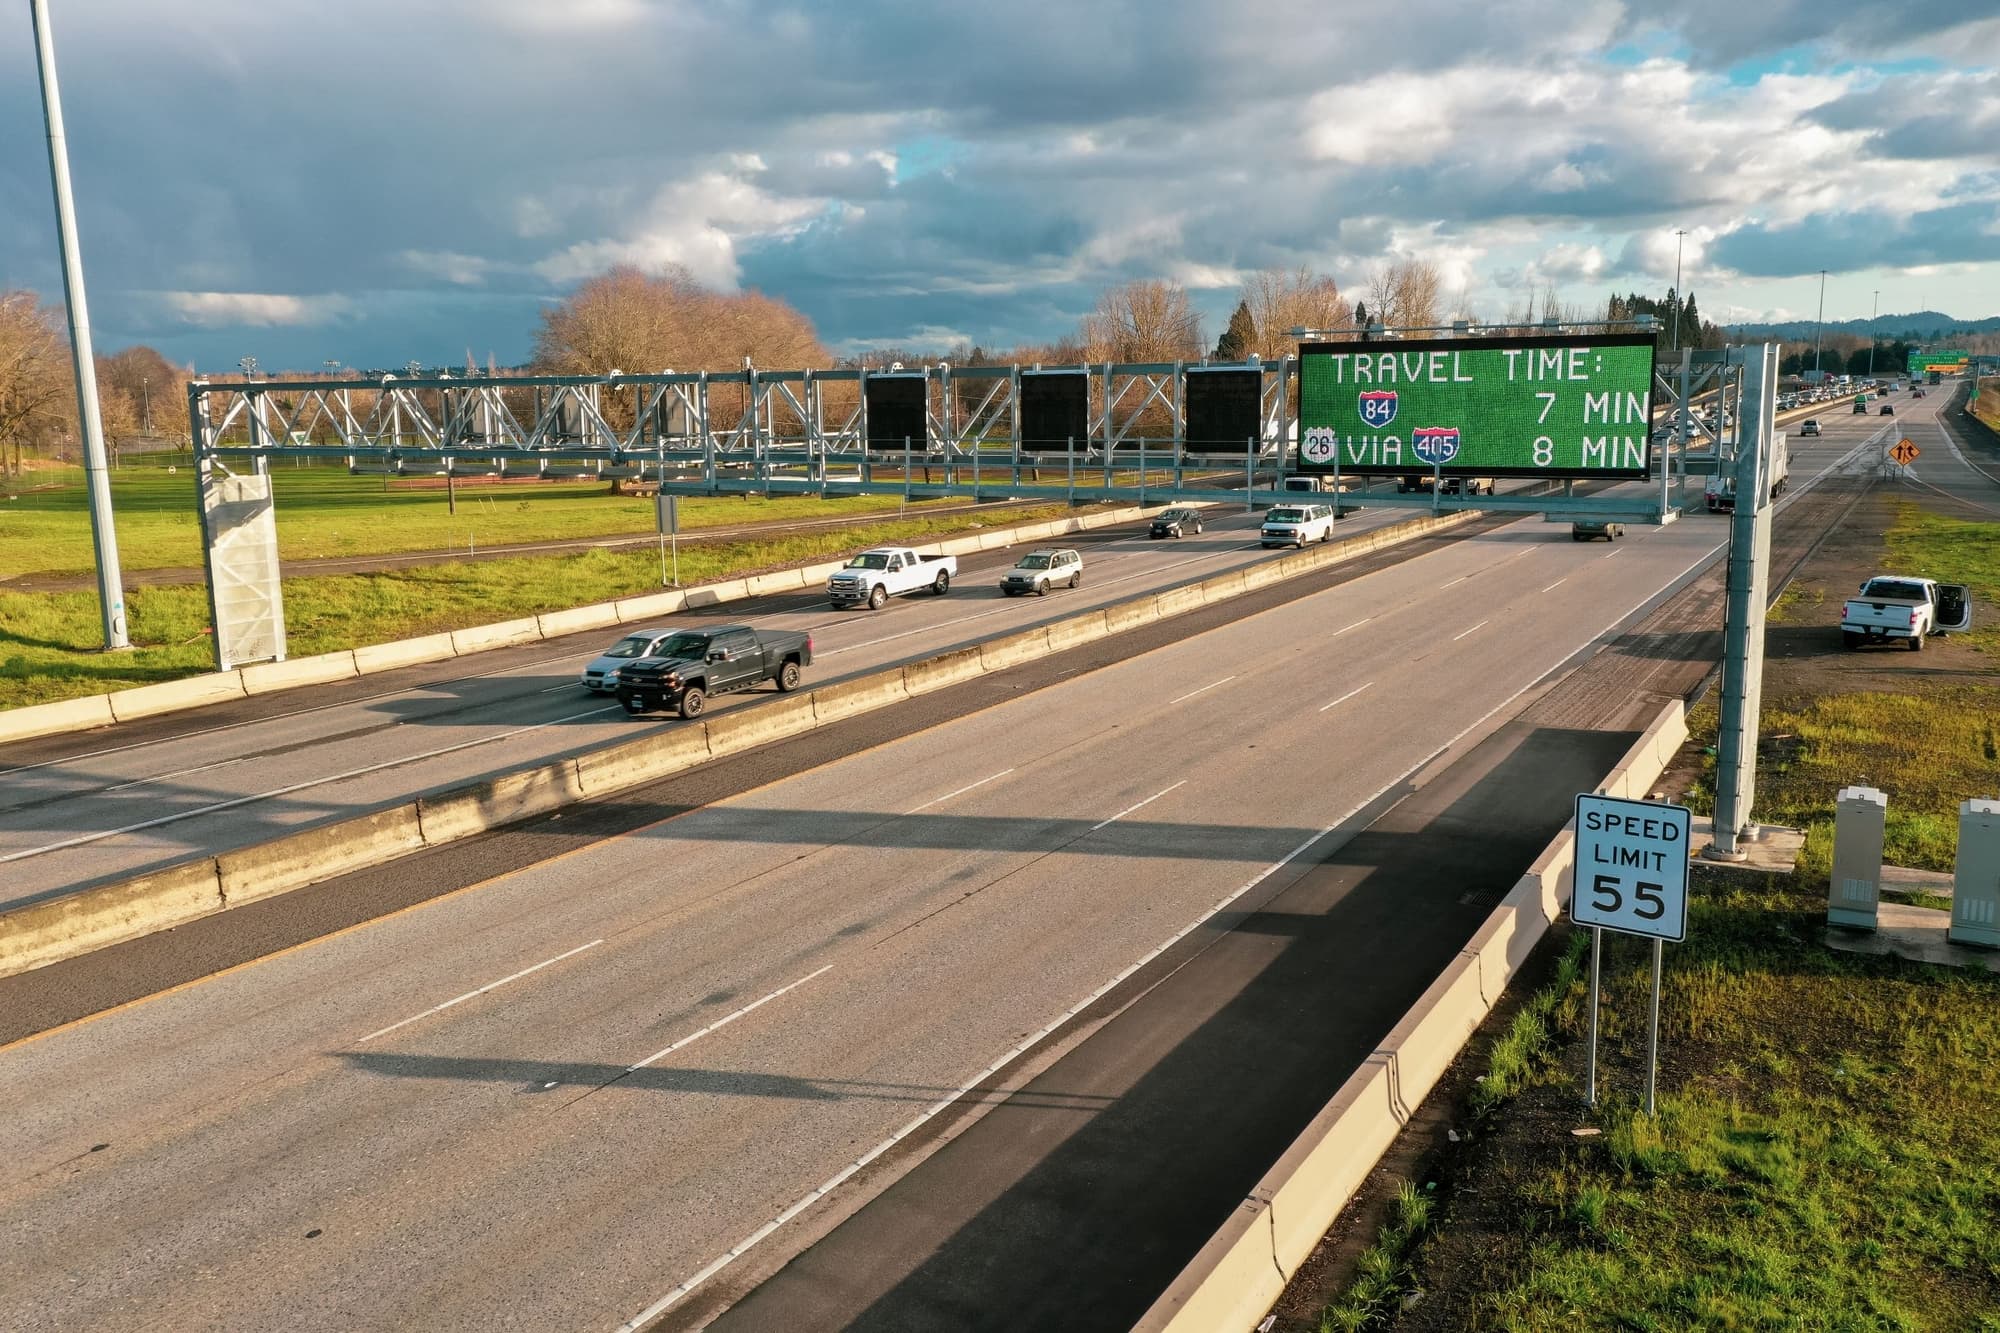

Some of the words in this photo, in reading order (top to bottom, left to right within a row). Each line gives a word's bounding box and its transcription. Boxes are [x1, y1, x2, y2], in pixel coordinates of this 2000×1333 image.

[1332, 352, 1473, 384] TRAVEL
[1502, 347, 1602, 381] TIME:
[1366, 400, 1390, 419] 84
[1535, 392, 1556, 424] 7
[1584, 391, 1650, 424] MIN
[1309, 436, 1330, 455] 26
[1347, 435, 1402, 465] VIA
[1417, 436, 1454, 457] 405
[1532, 436, 1554, 467] 8
[1582, 436, 1647, 468] MIN
[1586, 811, 1679, 842] SPEED
[1594, 843, 1667, 872] LIMIT
[1591, 874, 1665, 920] 55
